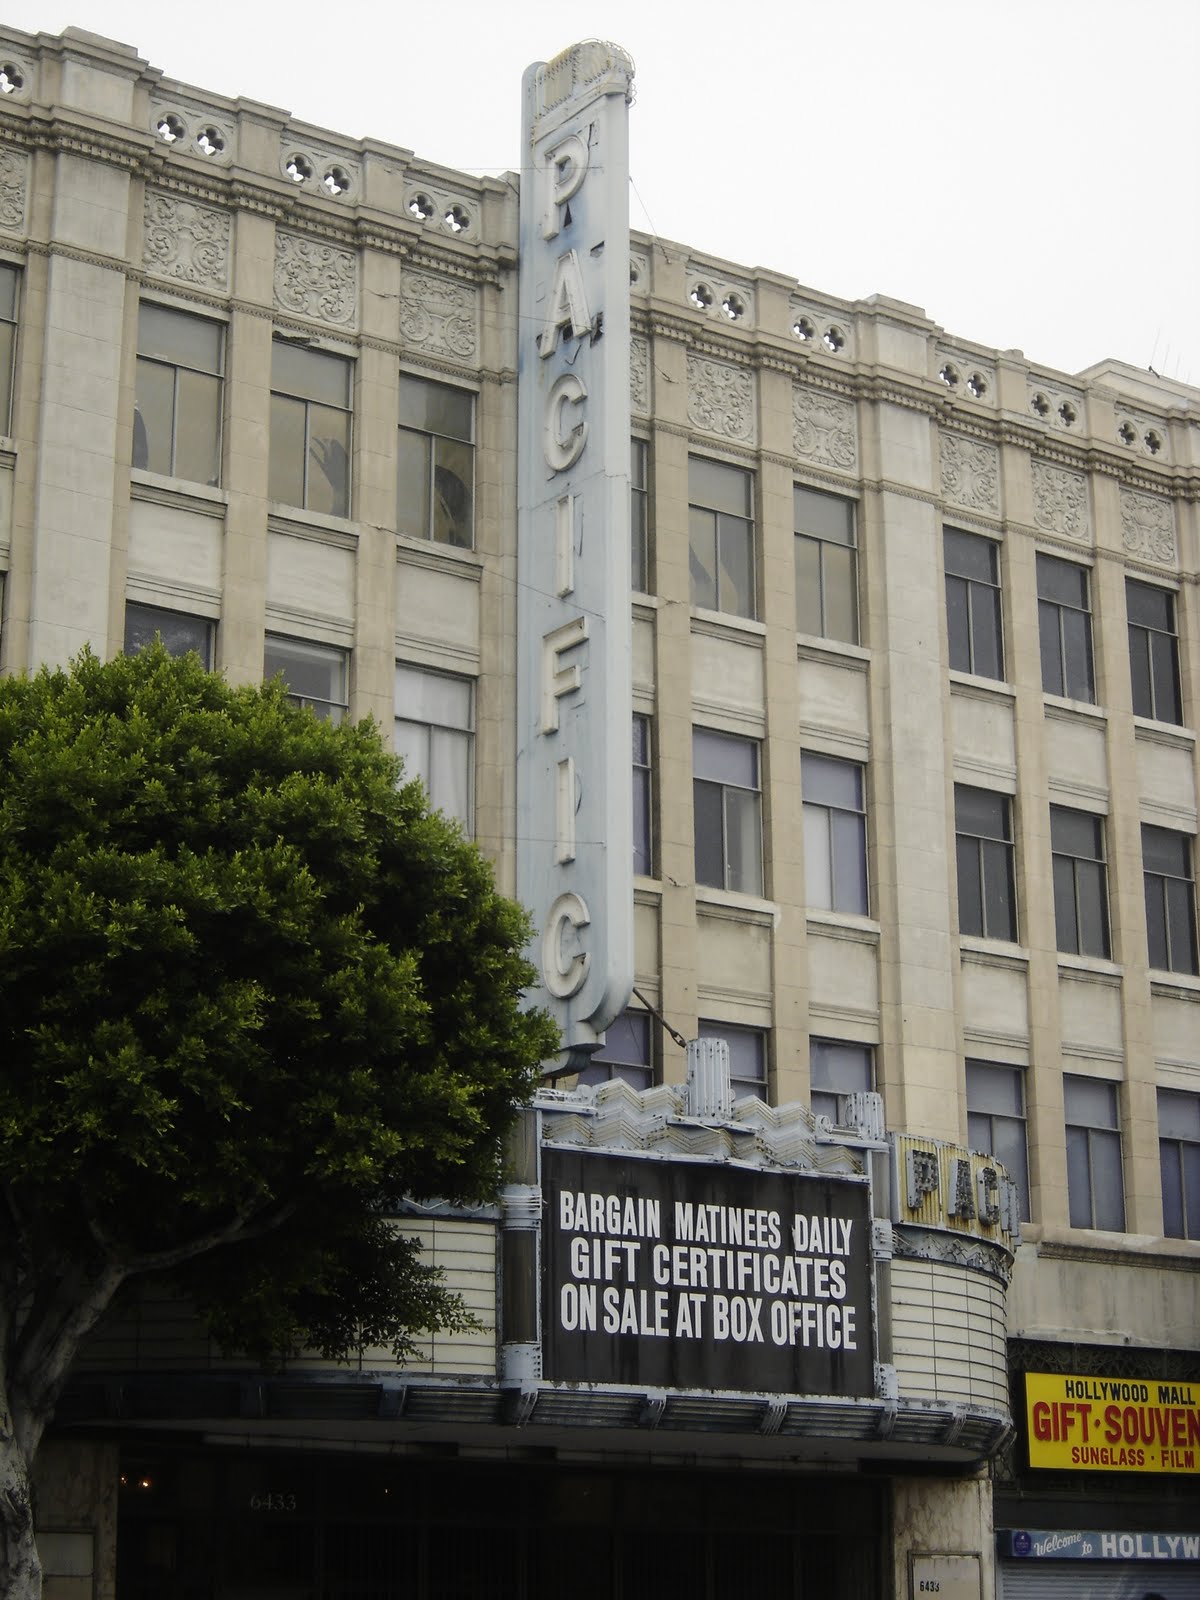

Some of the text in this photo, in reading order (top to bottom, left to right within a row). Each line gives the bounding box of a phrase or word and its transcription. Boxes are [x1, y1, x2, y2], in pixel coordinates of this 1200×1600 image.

[538, 133, 593, 999] PACIFIC
[559, 1190, 853, 1256] BARGAIN MATINEES DAILY
[570, 1236, 847, 1300] GIFT CERTIFICATES
[560, 1283, 858, 1351] ON SALE AT BOX OFFICE
[1065, 1379, 1196, 1406] HOLLYWOOD MALL
[1033, 1401, 1092, 1442] GIFT
[1071, 1446, 1195, 1469] SUNGLASS FILM
[249, 1490, 298, 1511] 6433
[1033, 1532, 1083, 1557] Welcome
[1081, 1541, 1093, 1557] to
[1101, 1534, 1200, 1560] HOLLYW
[919, 1580, 940, 1593] 6433
